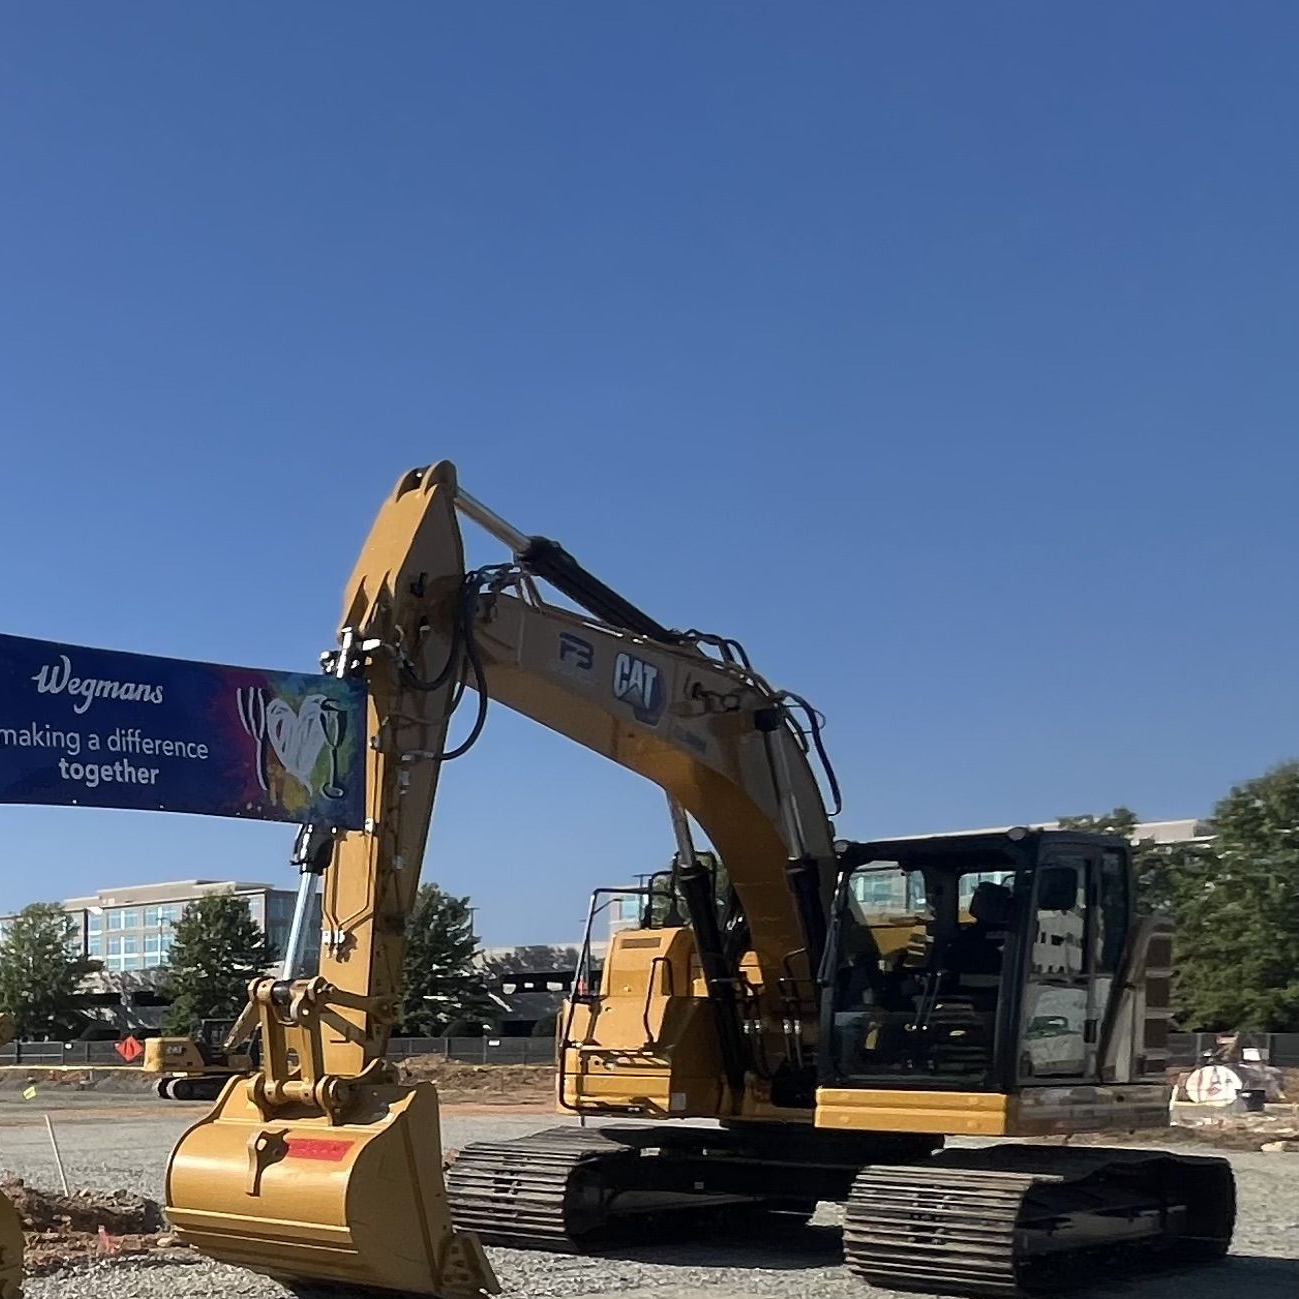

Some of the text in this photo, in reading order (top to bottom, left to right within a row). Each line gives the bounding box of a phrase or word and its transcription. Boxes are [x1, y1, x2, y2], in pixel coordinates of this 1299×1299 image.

[31, 654, 164, 715] Wegmans
[613, 652, 658, 710] CAT
[87, 733, 101, 751] a
[107, 727, 210, 760] difference
[58, 757, 160, 788] together
